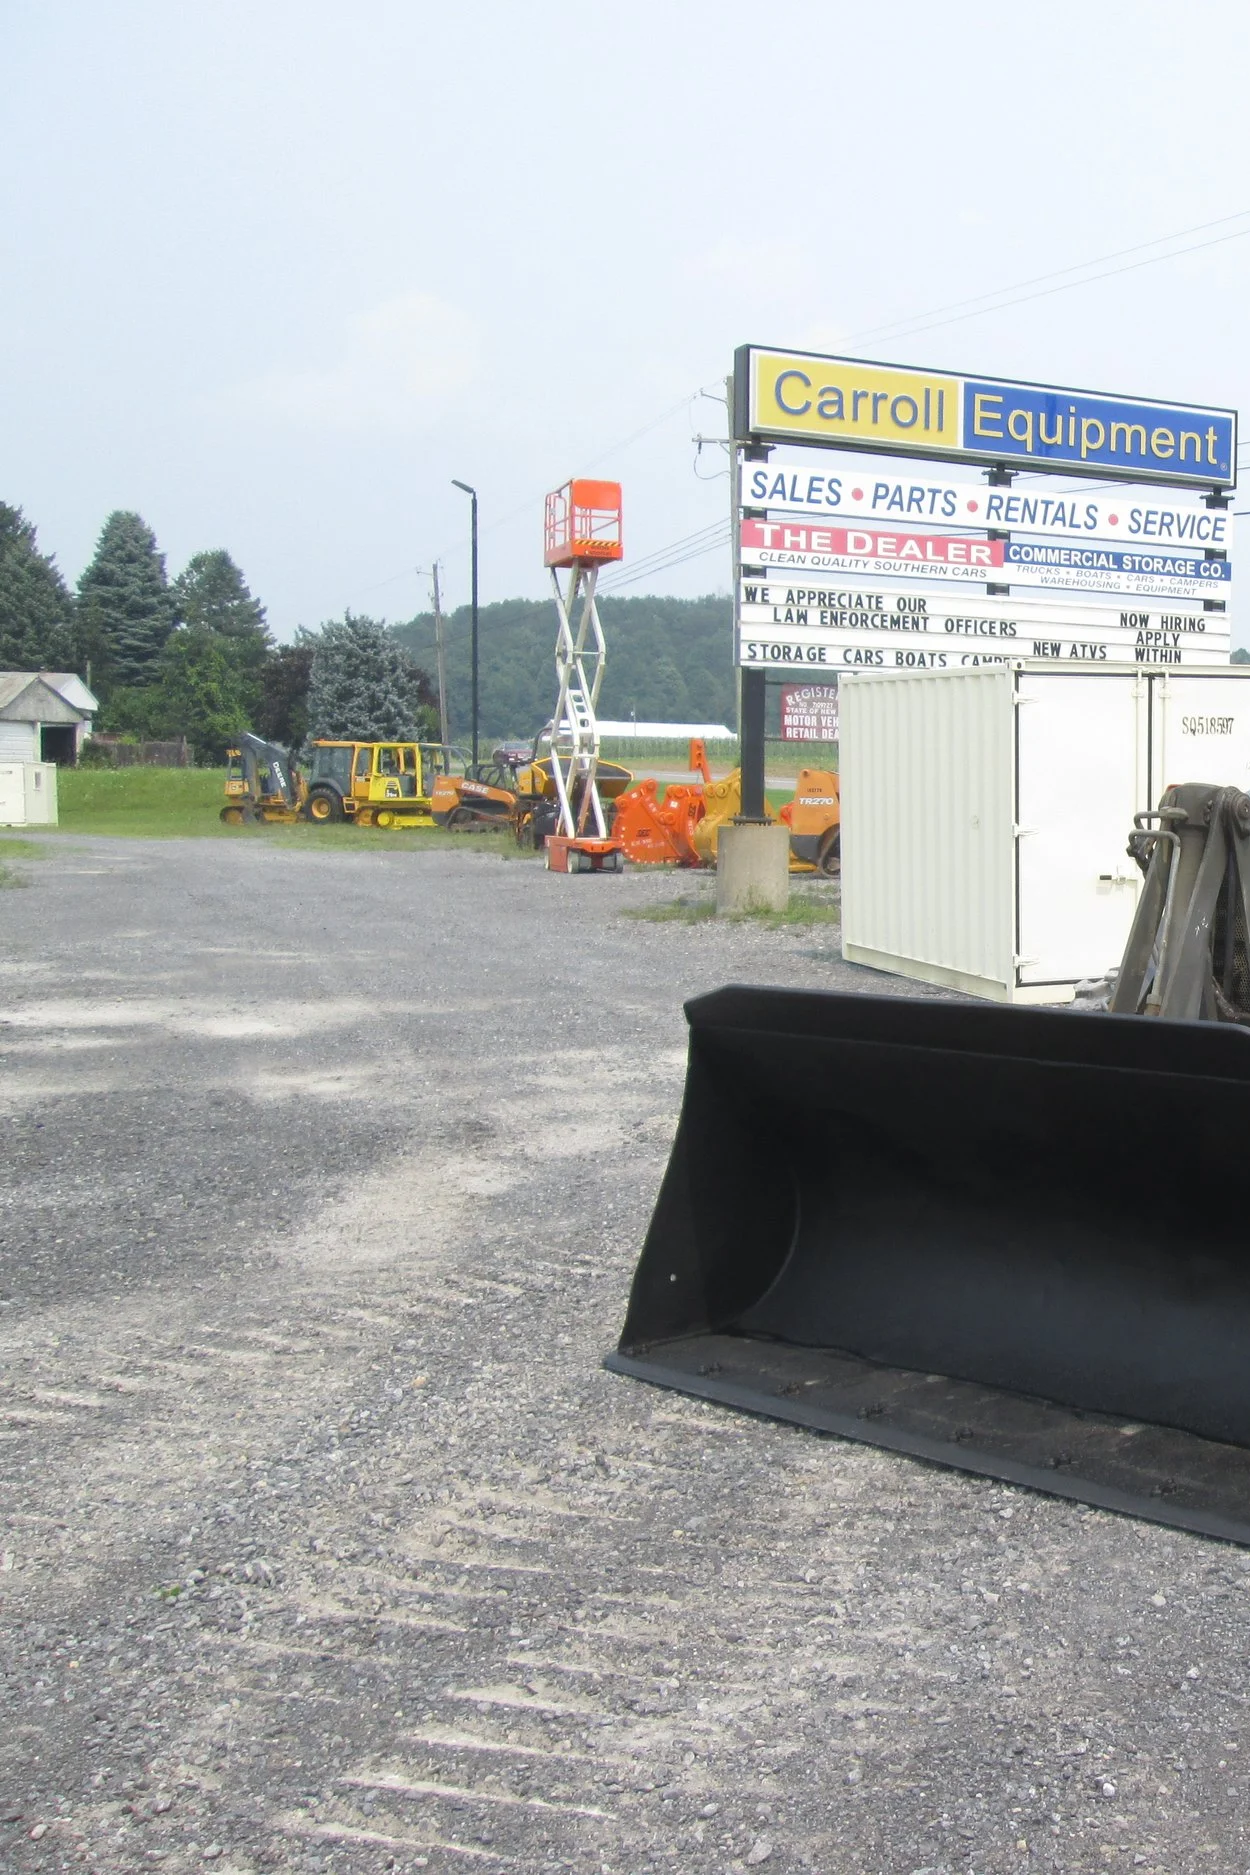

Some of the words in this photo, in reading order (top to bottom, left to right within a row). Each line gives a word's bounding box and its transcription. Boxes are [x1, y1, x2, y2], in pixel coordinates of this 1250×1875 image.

[775, 370, 944, 432] Carroll
[973, 393, 1218, 465] Equipment
[750, 470, 842, 505] SALES
[872, 483, 957, 517] PARTS
[986, 494, 1098, 530] RENTALS
[1128, 508, 1227, 542] SERVICE
[755, 523, 832, 551] THE
[847, 531, 992, 565] DEALER
[759, 552, 806, 565] CLEAN
[811, 555, 869, 569] QUALITY
[874, 560, 948, 575] SOUTHERN
[952, 567, 987, 578] CARS
[1009, 545, 1117, 569] COMMERCIAL
[1122, 556, 1195, 576] STORAGE
[1200, 563, 1225, 578] CO.
[1015, 565, 1061, 576] TRUCKS
[1076, 570, 1112, 580] BOATS
[1127, 574, 1155, 584] CARS
[1169, 578, 1219, 589] CAMPERS
[1040, 576, 1121, 590] WAREHOUSING
[1135, 584, 1198, 596] EQUIPMENT
[744, 586, 770, 603] WE
[785, 589, 883, 610] APPRECIATE
[897, 597, 927, 613] OUR
[773, 607, 808, 625] LAW
[820, 610, 930, 631] ENFORCEMENT
[945, 618, 1017, 636] OFFICERS
[1120, 613, 1149, 629] NOW
[1161, 615, 1205, 632] HIRING
[1033, 641, 1061, 657] NEW
[1136, 631, 1180, 647] APPLY
[747, 643, 826, 662] STORAGE
[843, 648, 884, 664] CARS
[895, 652, 947, 667] BOATS
[1135, 647, 1182, 664] WITHIN
[784, 715, 817, 726] MOTOR
[786, 727, 818, 739] RETAIL
[272, 761, 286, 788] DEERE
[461, 782, 489, 794] CASE
[799, 797, 834, 805] TR270
